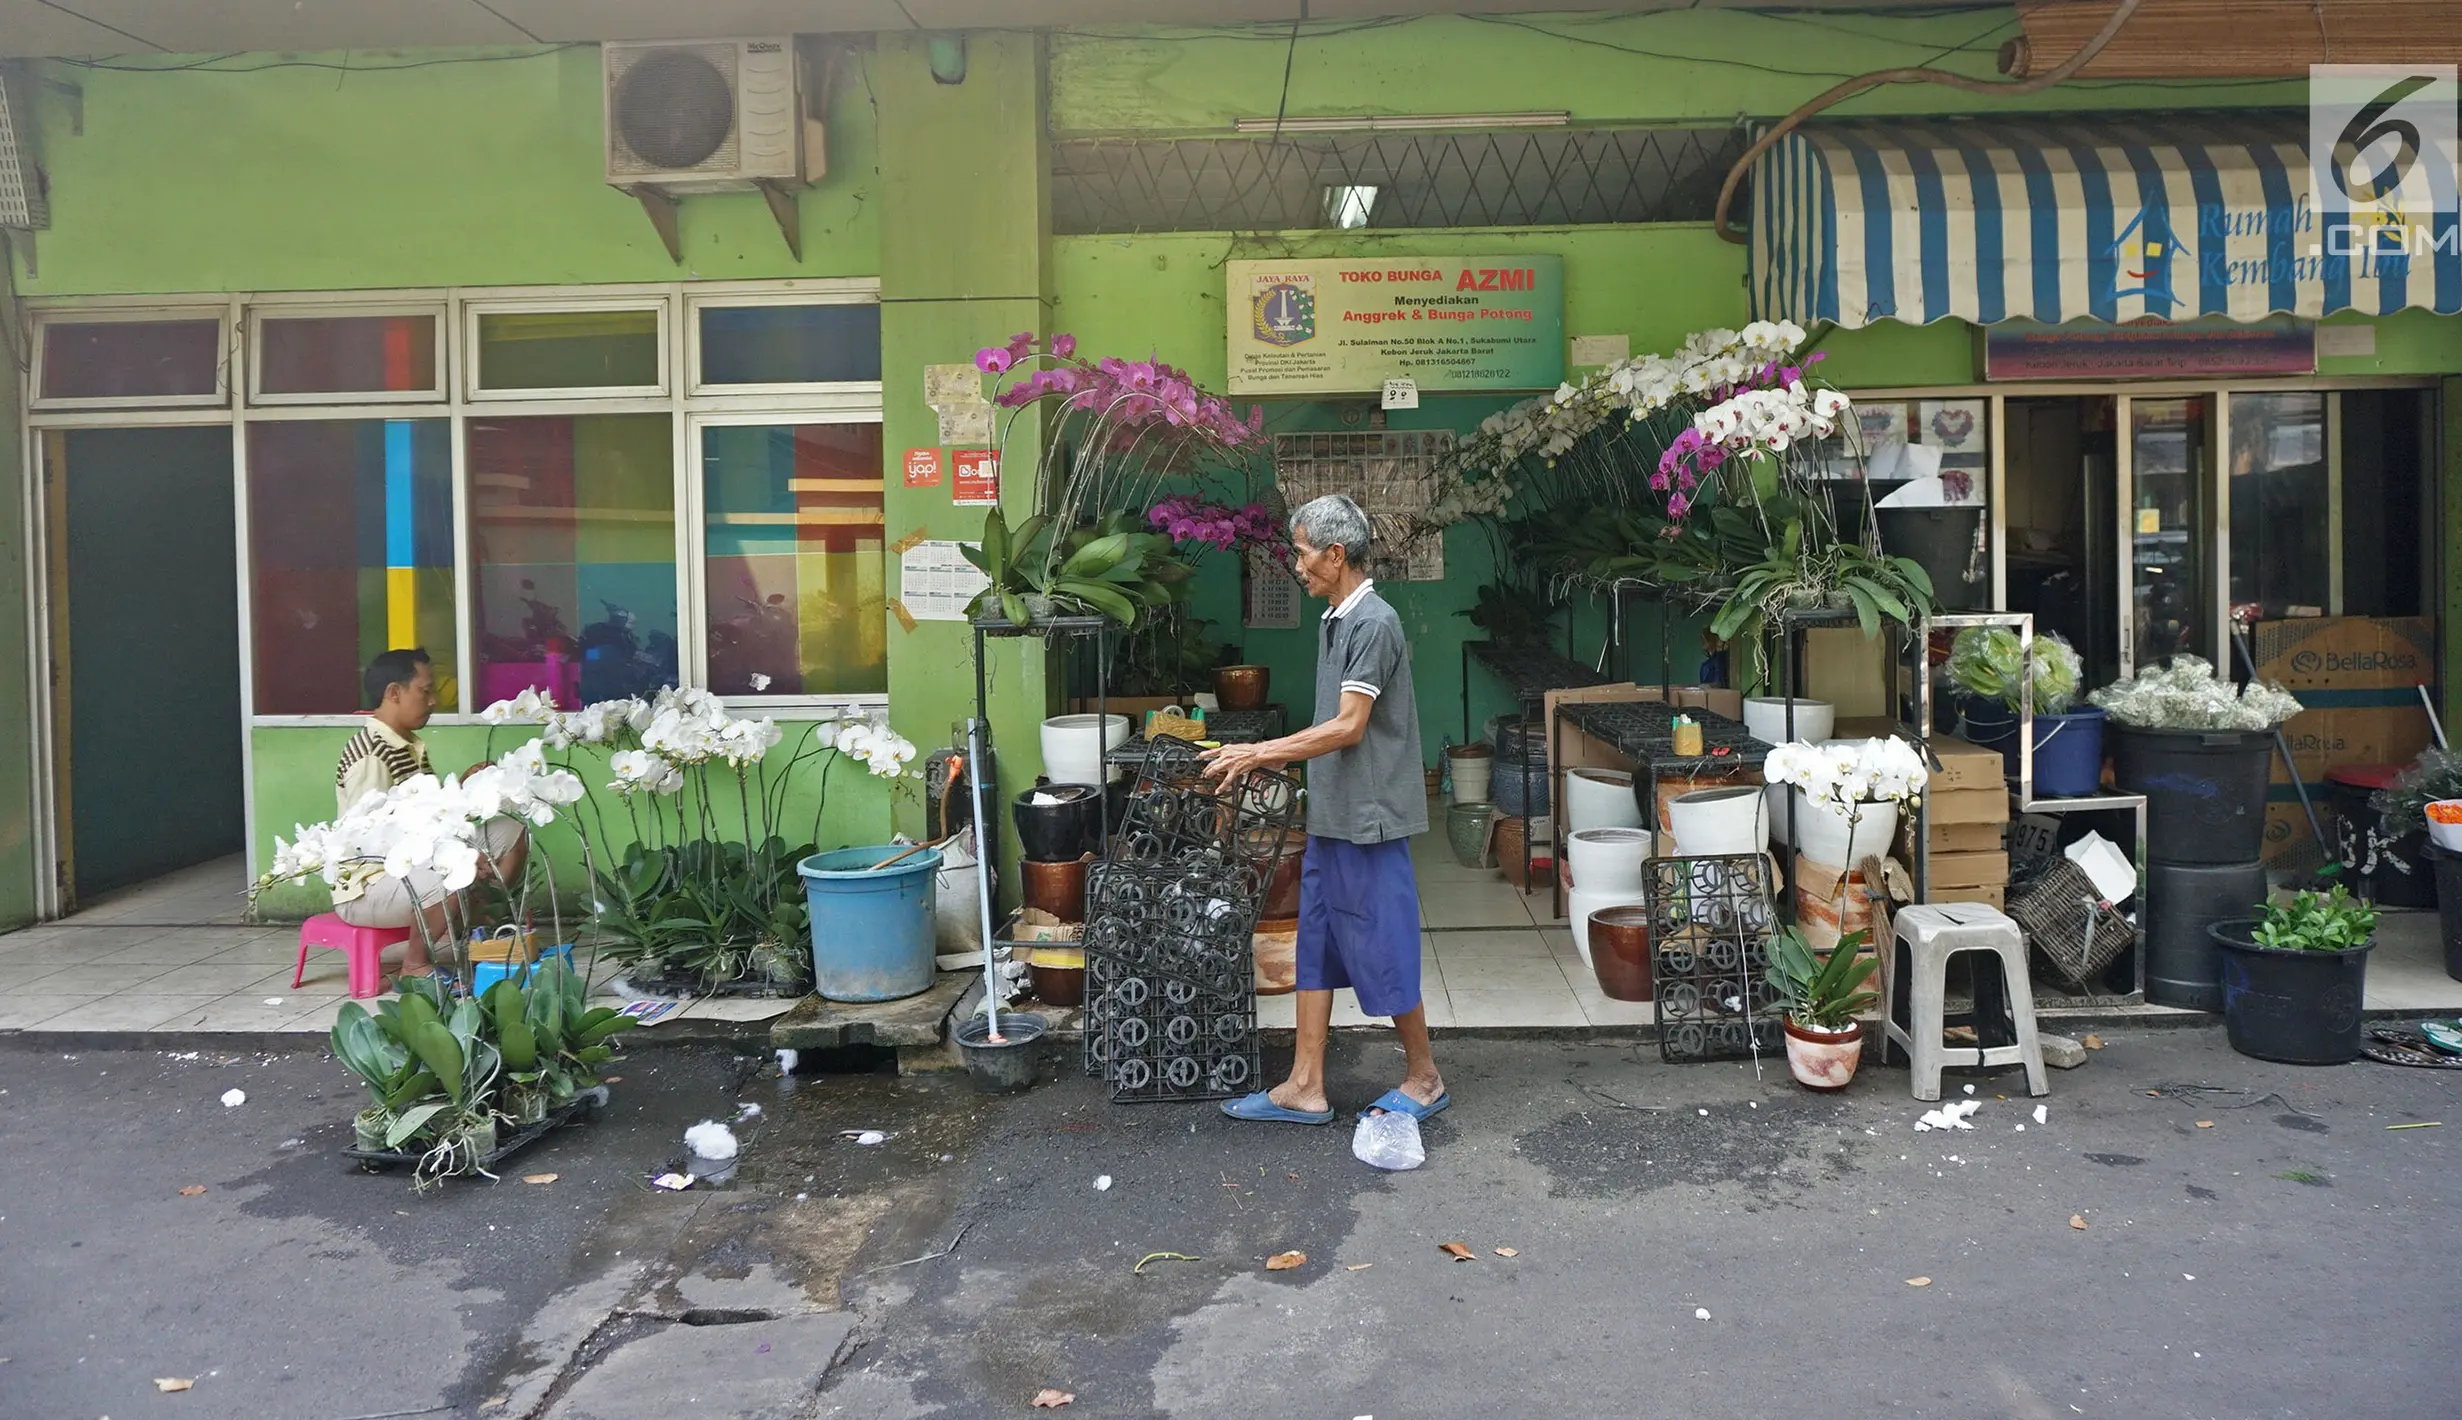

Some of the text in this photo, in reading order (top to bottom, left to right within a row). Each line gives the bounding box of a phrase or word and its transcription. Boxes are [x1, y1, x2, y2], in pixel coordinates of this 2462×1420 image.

[2200, 193, 2313, 239] Rumah
[2201, 240, 2347, 293] Kembang
[1256, 274, 1310, 283] JAYA RAYA
[1339, 268, 1535, 291] TOKO BUNGA AZMI
[1394, 296, 1480, 307] Menyediakan
[1343, 308, 1533, 324] Anggrek & Bunga Potong
[1417, 337, 1435, 345] Blok
[1438, 337, 1445, 345] A
[1513, 336, 1537, 344] Utara
[1381, 348, 1408, 356] Kebon
[1436, 347, 1469, 355] Jakarta
[2326, 651, 2416, 672] BellaRosa
